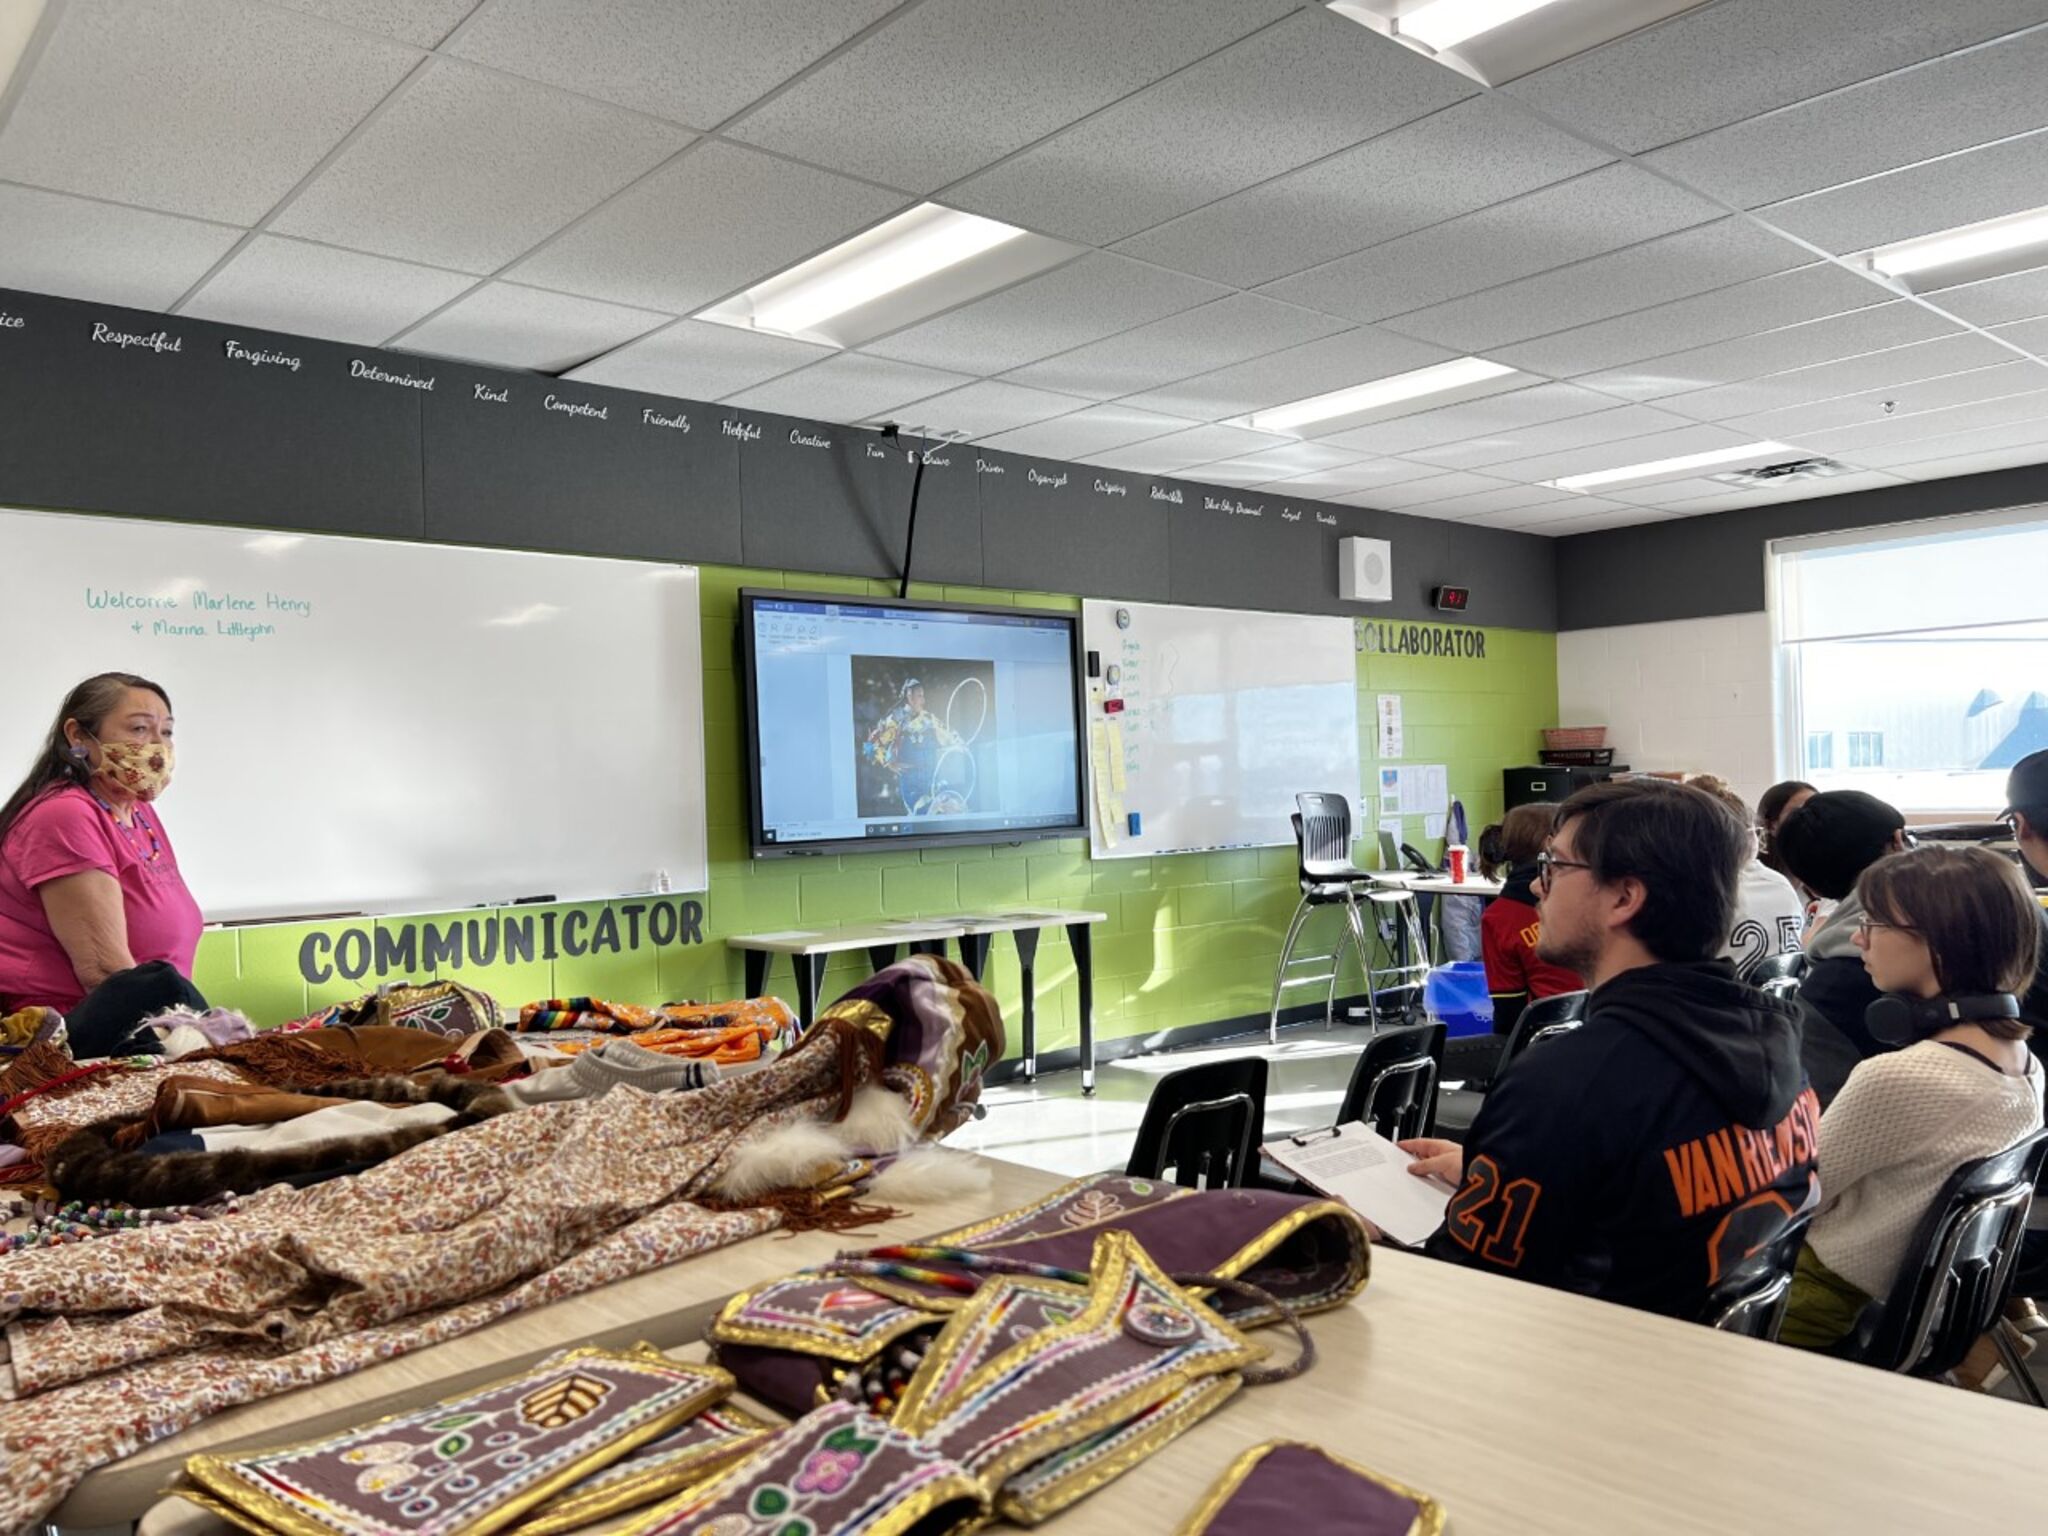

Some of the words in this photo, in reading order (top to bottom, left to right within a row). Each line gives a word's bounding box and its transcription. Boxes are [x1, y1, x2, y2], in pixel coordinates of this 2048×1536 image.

[92, 322, 182, 352] Respectful
[226, 340, 301, 372] Forgiving
[351, 359, 435, 391] Determined
[474, 383, 508, 402] Kind
[544, 394, 608, 420] Competent
[643, 409, 690, 433] Friendly
[722, 420, 761, 441] Helpful
[789, 429, 831, 449] Creative
[866, 443, 885, 458] Fun
[976, 459, 1005, 474] Driven
[1028, 468, 1067, 488] Organized
[86, 587, 178, 610] Welcome
[192, 590, 257, 611] Marlene
[266, 592, 312, 618] Henry
[298, 899, 704, 985] COMMUNICATOR
[1447, 1153, 1542, 1268] 21
